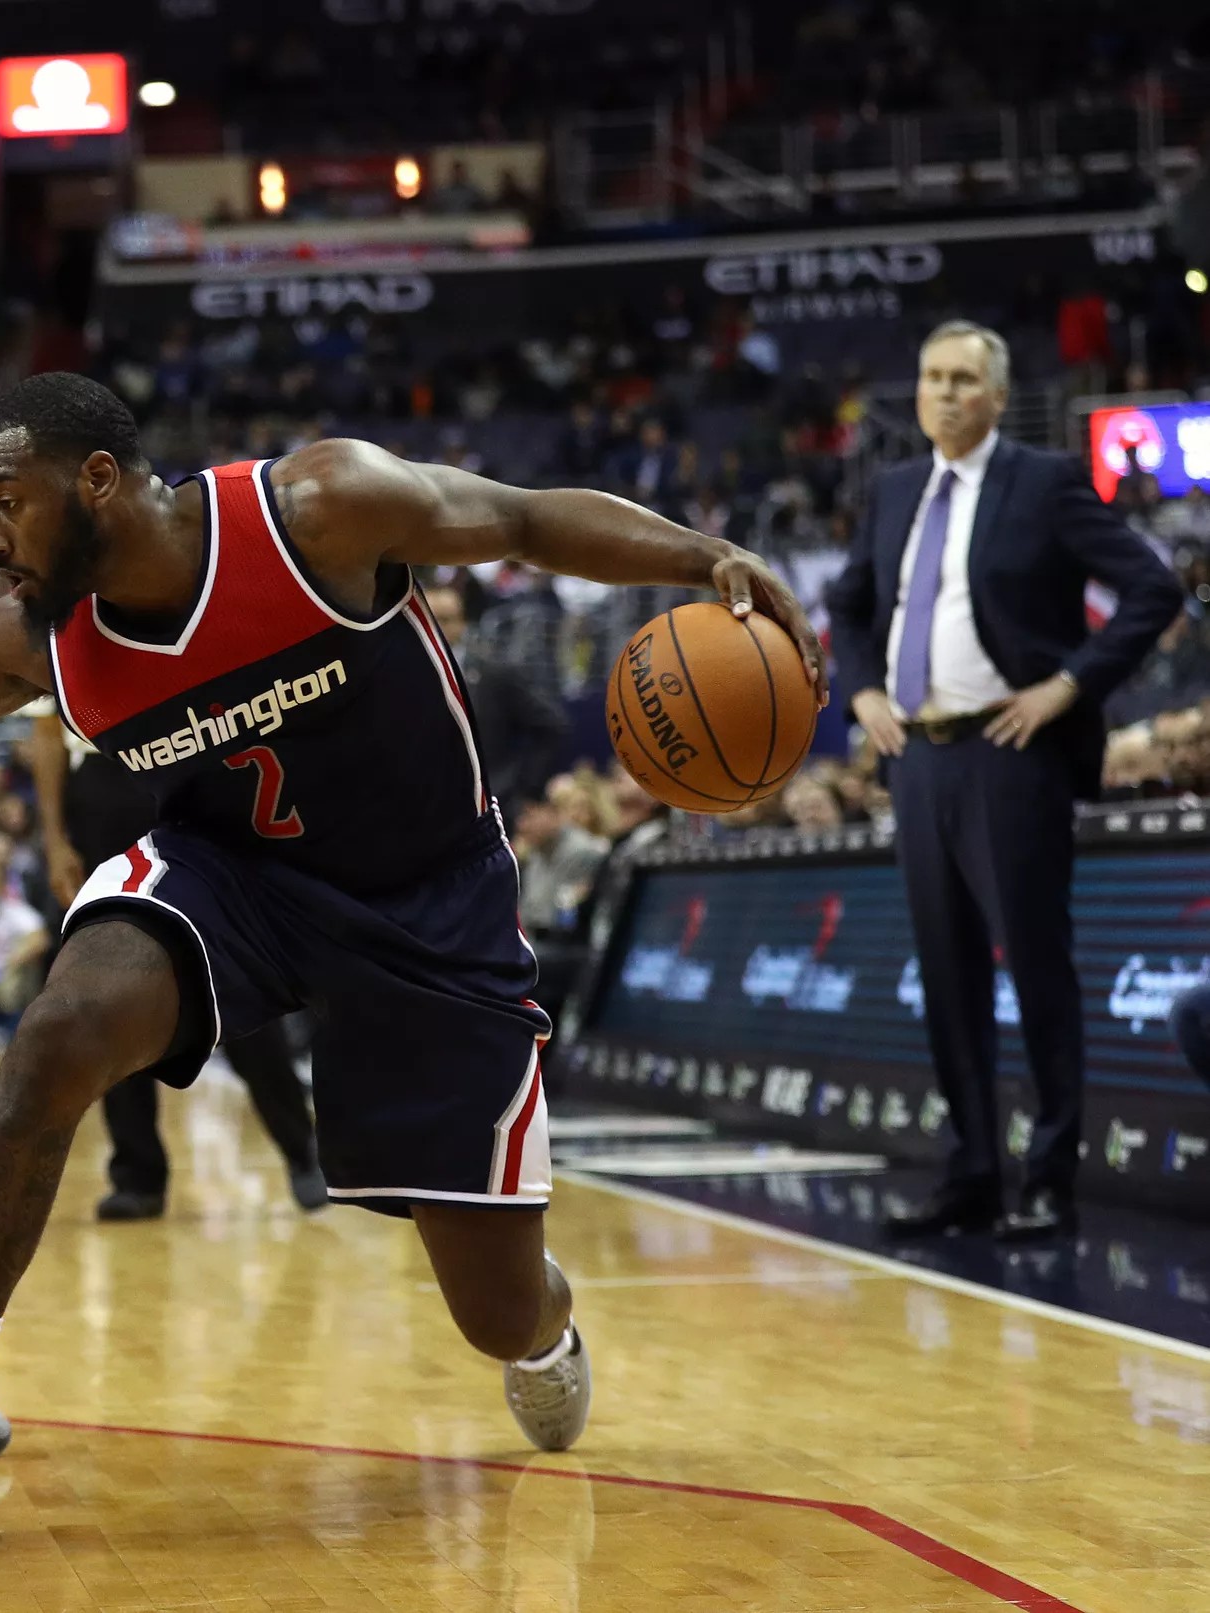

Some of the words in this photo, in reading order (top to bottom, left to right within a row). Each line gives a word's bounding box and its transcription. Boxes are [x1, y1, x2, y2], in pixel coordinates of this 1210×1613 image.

[704, 242, 942, 294] ETIHAD
[117, 659, 348, 772] washington
[629, 633, 698, 771] SPALDING
[222, 745, 305, 839] 2
